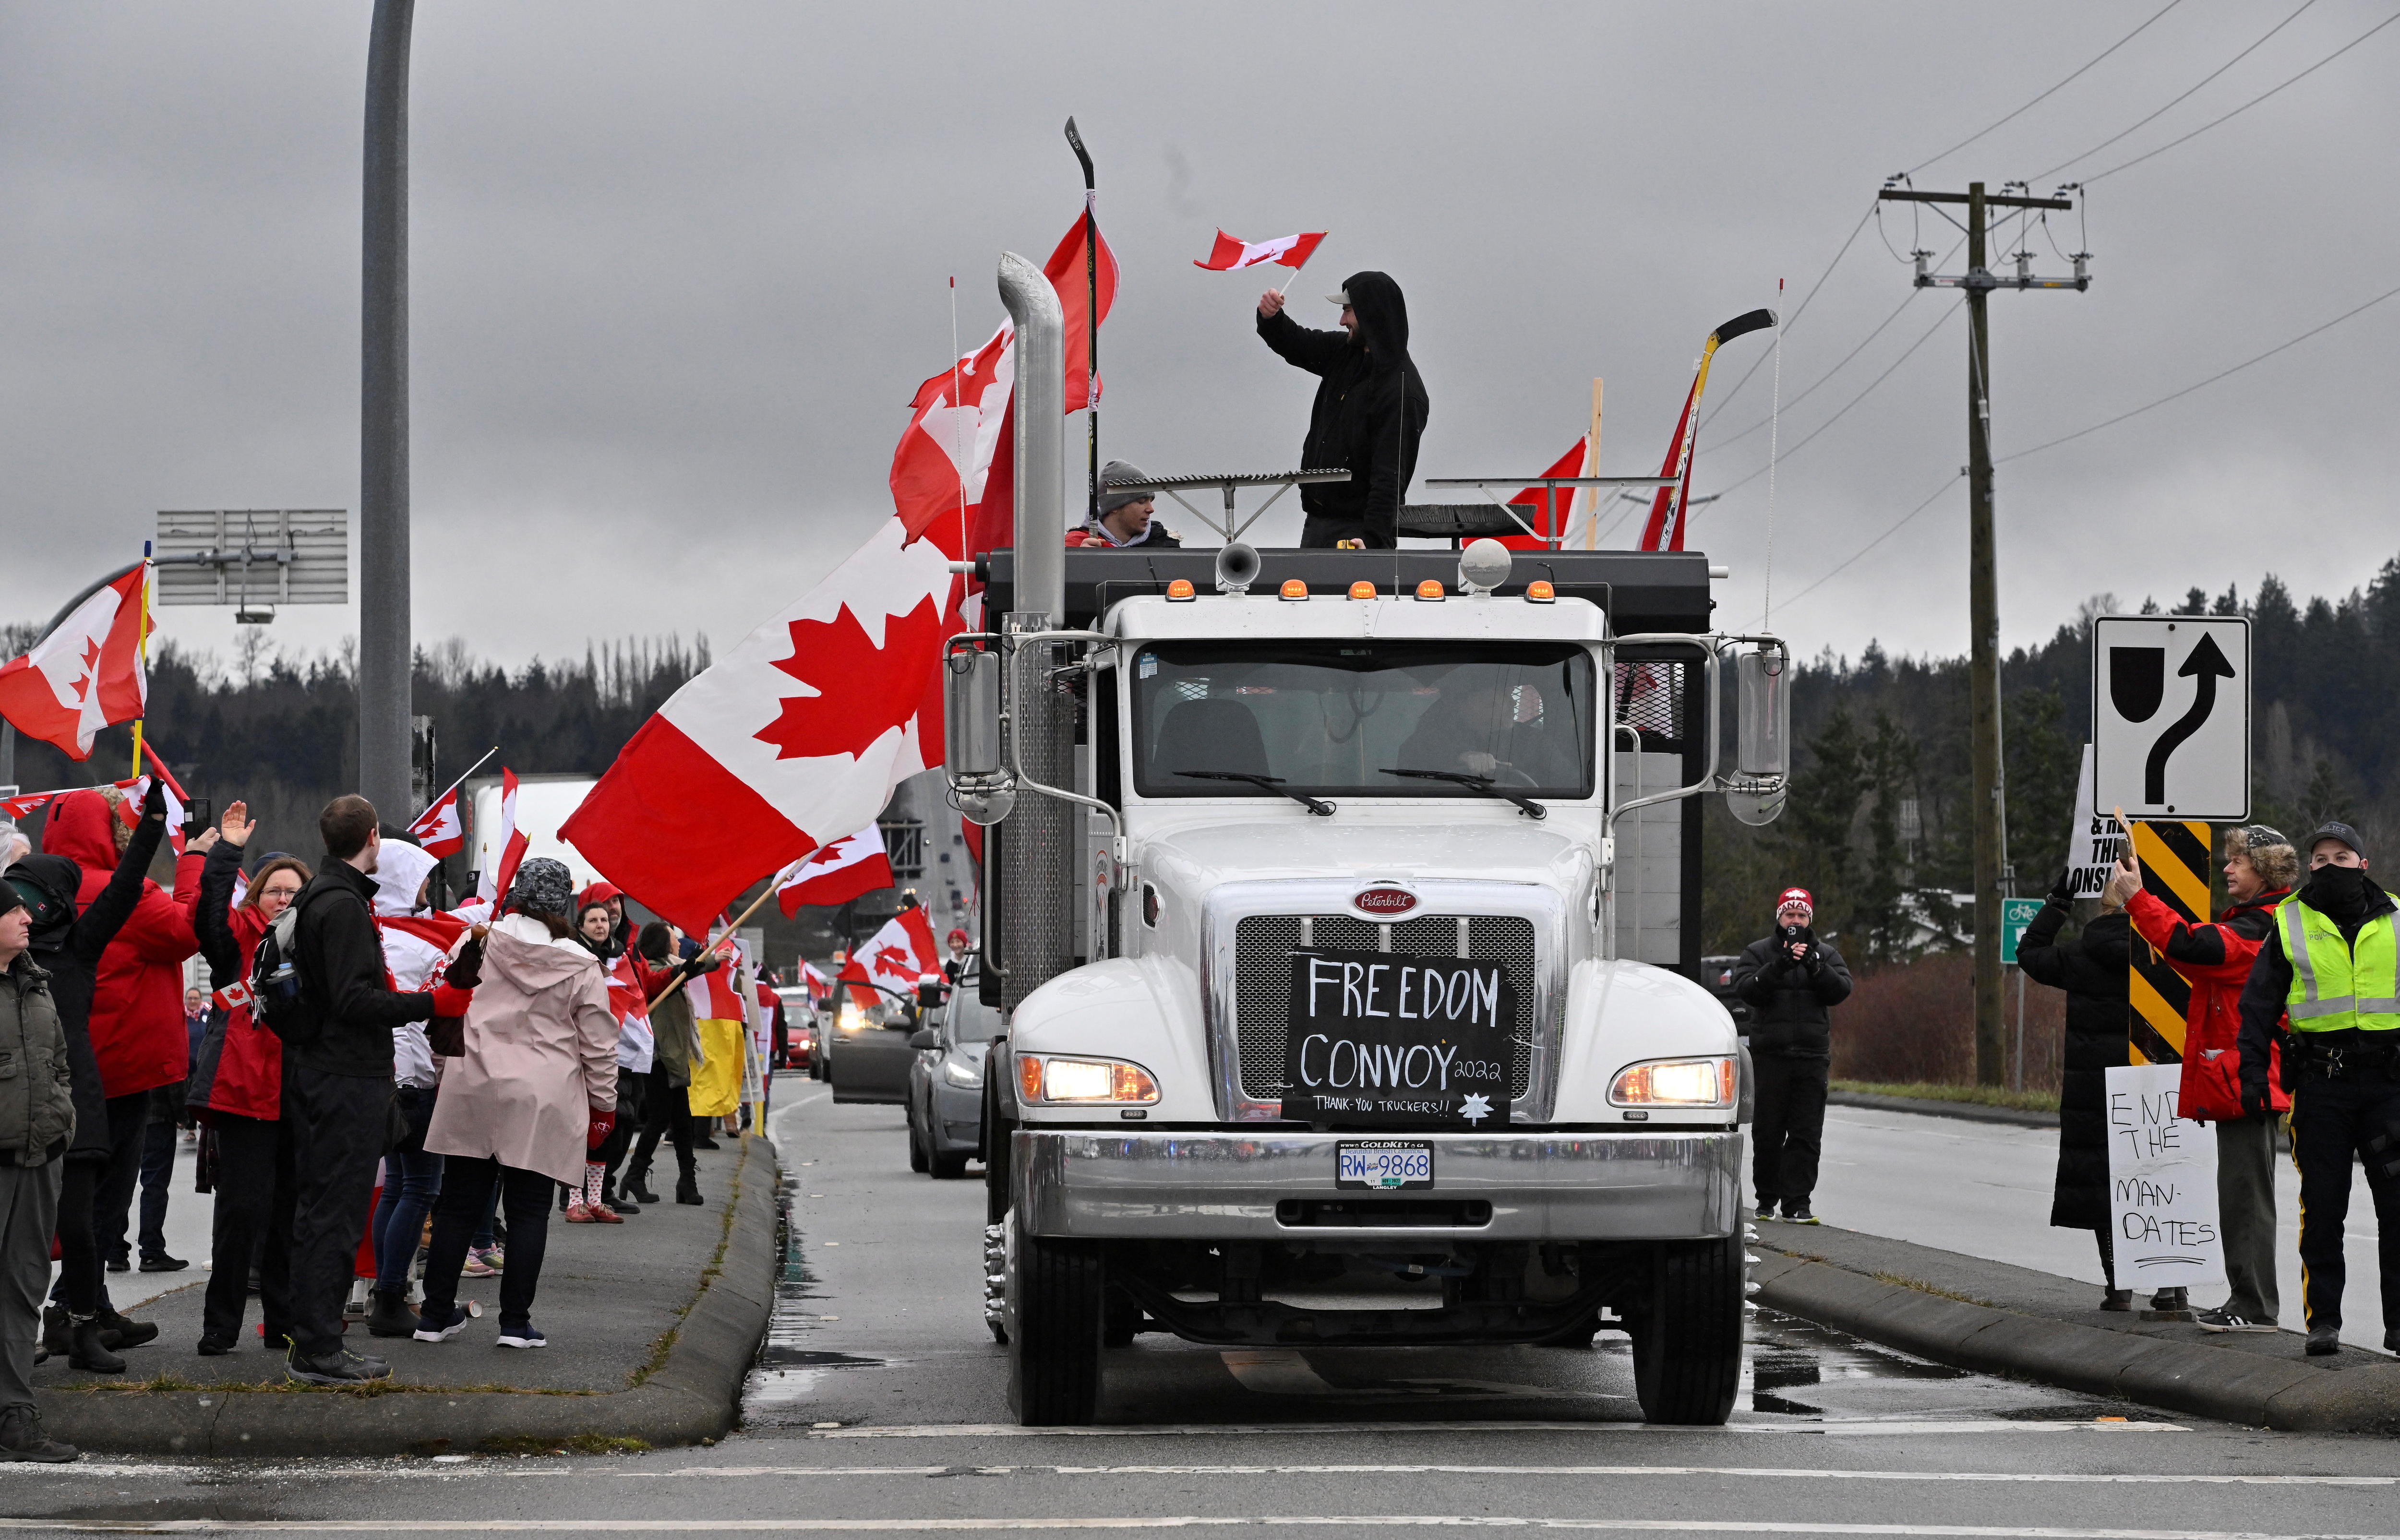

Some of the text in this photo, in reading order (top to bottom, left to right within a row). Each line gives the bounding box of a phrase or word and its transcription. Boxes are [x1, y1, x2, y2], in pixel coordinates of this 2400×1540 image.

[1361, 893, 1411, 907] Peterbilt
[1309, 957, 1498, 1027] FREEDOM
[1301, 1034, 1501, 1090] CONVOY 2022
[1378, 1100, 1449, 1117] TRUCKERS!!
[2119, 1125, 2180, 1159] THE
[1379, 1155, 1428, 1176] 9868
[2123, 1213, 2215, 1246] DATES
